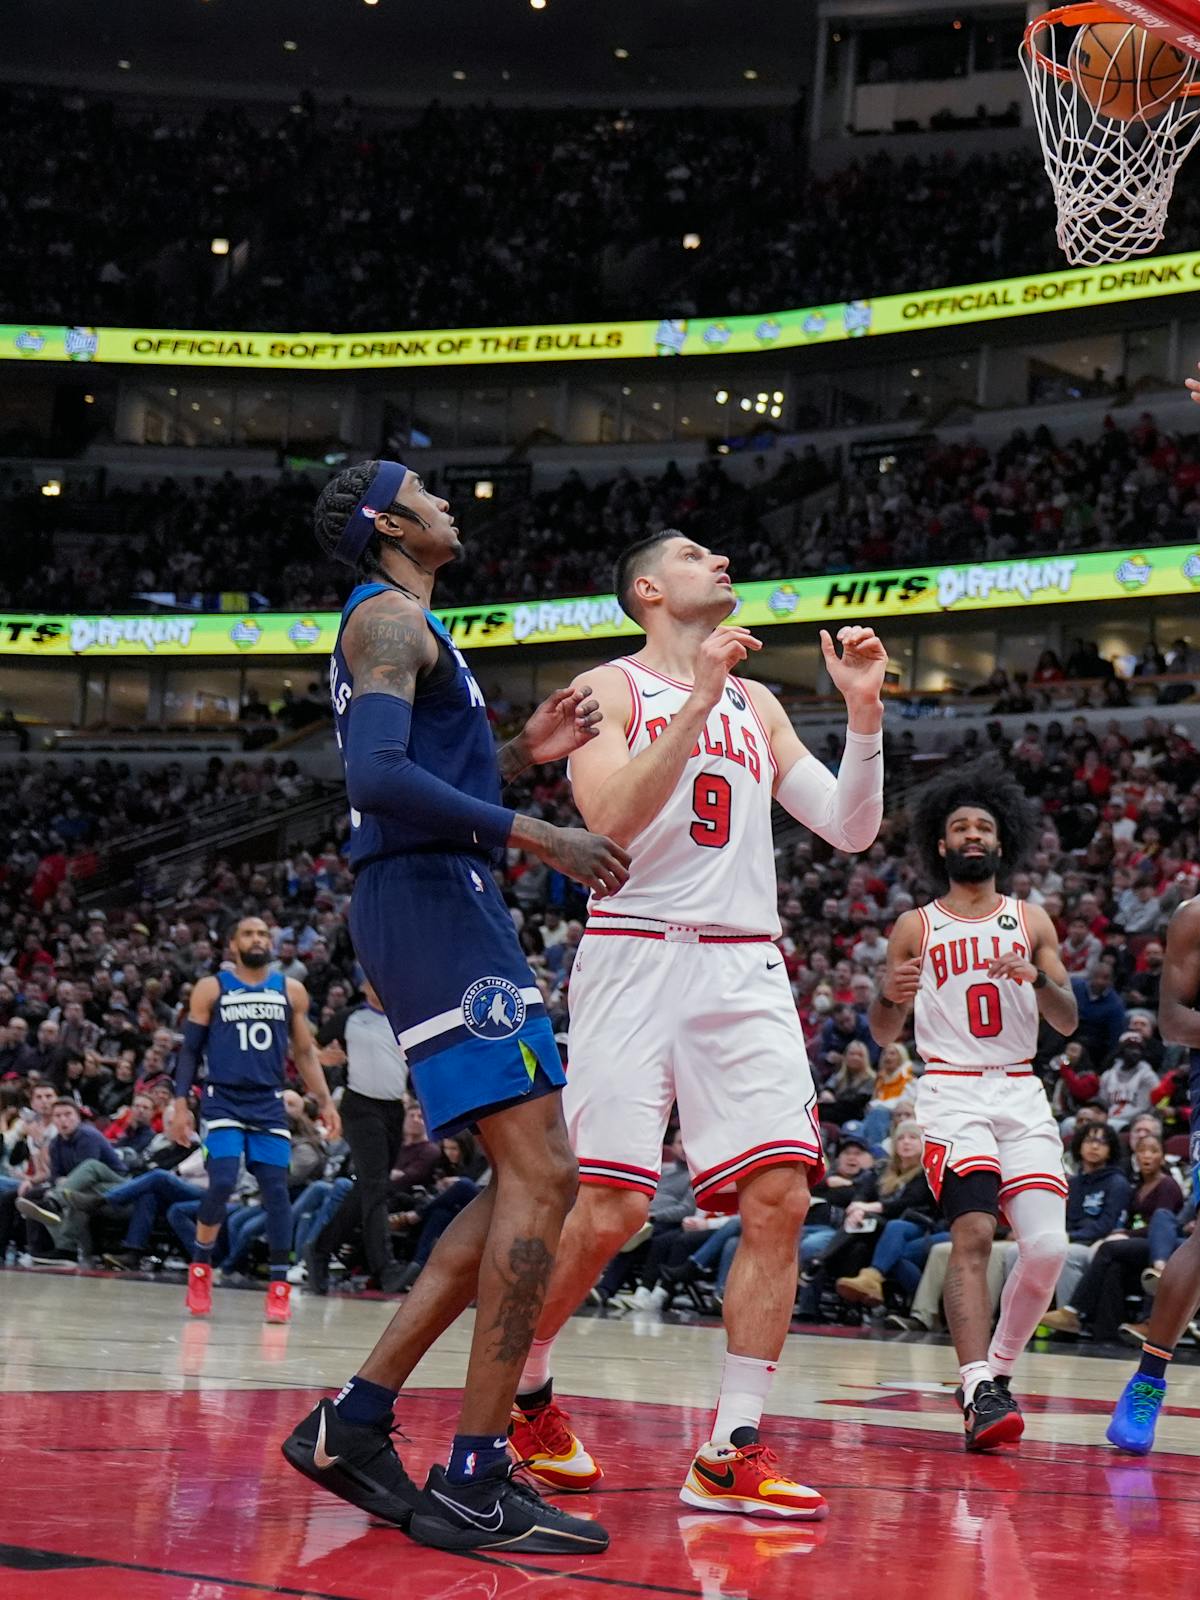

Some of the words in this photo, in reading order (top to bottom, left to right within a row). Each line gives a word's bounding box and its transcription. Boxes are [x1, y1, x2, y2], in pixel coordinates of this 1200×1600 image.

[902, 288, 1014, 319] OFFICIAL
[1022, 277, 1093, 304] SOFT
[1100, 265, 1186, 292] DRINK
[133, 338, 261, 357] OFFICIAL
[270, 342, 345, 359] SOFT
[350, 340, 430, 358] DRINK
[436, 338, 472, 354] OF
[480, 335, 531, 353] THE
[535, 331, 623, 350] BULLS
[825, 576, 929, 606] HITS
[937, 559, 1076, 608] DIFFERENT
[0, 622, 63, 642] TS
[442, 612, 507, 636] ITS
[645, 713, 761, 784] LLS
[690, 772, 731, 848] 9
[220, 1003, 286, 1022] MINNESOTA
[966, 982, 1002, 1038] 0
[236, 1021, 272, 1051] 10
